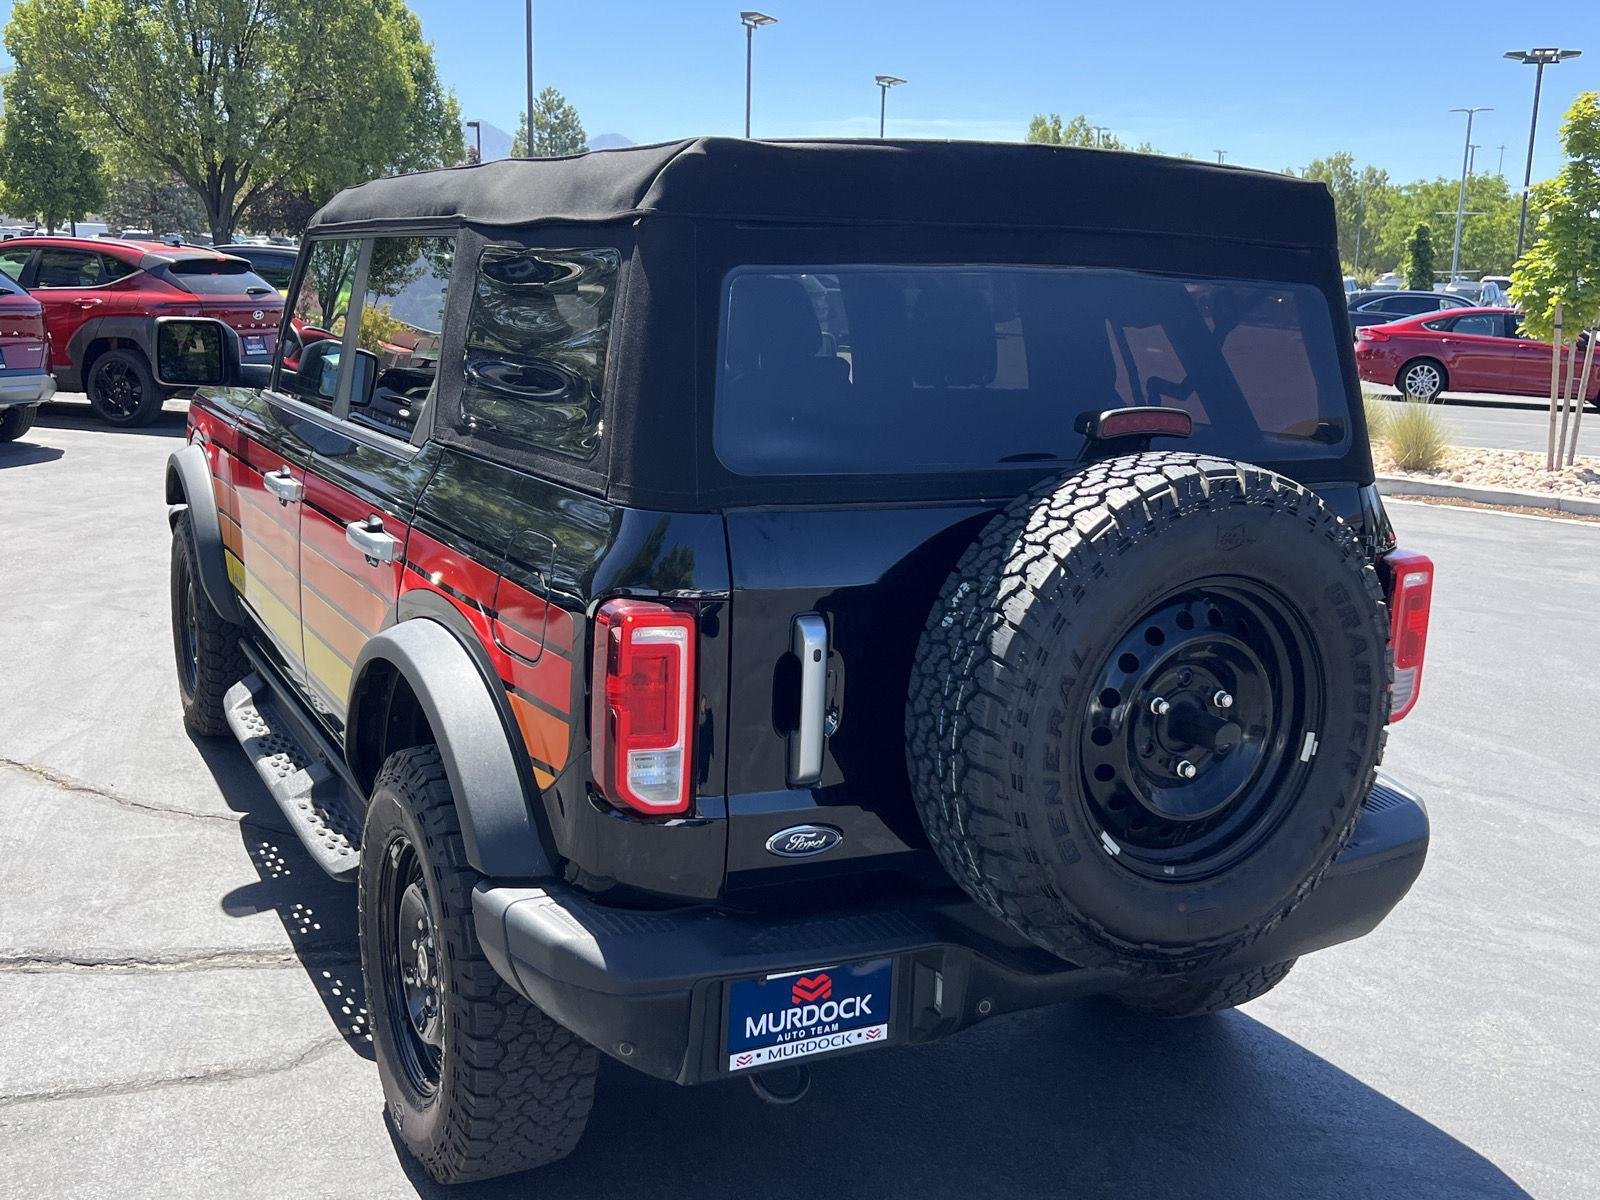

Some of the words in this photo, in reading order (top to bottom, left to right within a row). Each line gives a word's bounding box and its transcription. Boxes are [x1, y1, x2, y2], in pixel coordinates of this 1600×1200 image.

[1326, 581, 1371, 776] GRABBER
[1042, 646, 1092, 866] GENERAL
[785, 832, 826, 850] Ford
[745, 993, 872, 1038] MURDOCK
[776, 1030, 805, 1043] AUTO
[811, 1022, 839, 1036] TEAM
[768, 1033, 853, 1060] MURDOCK
